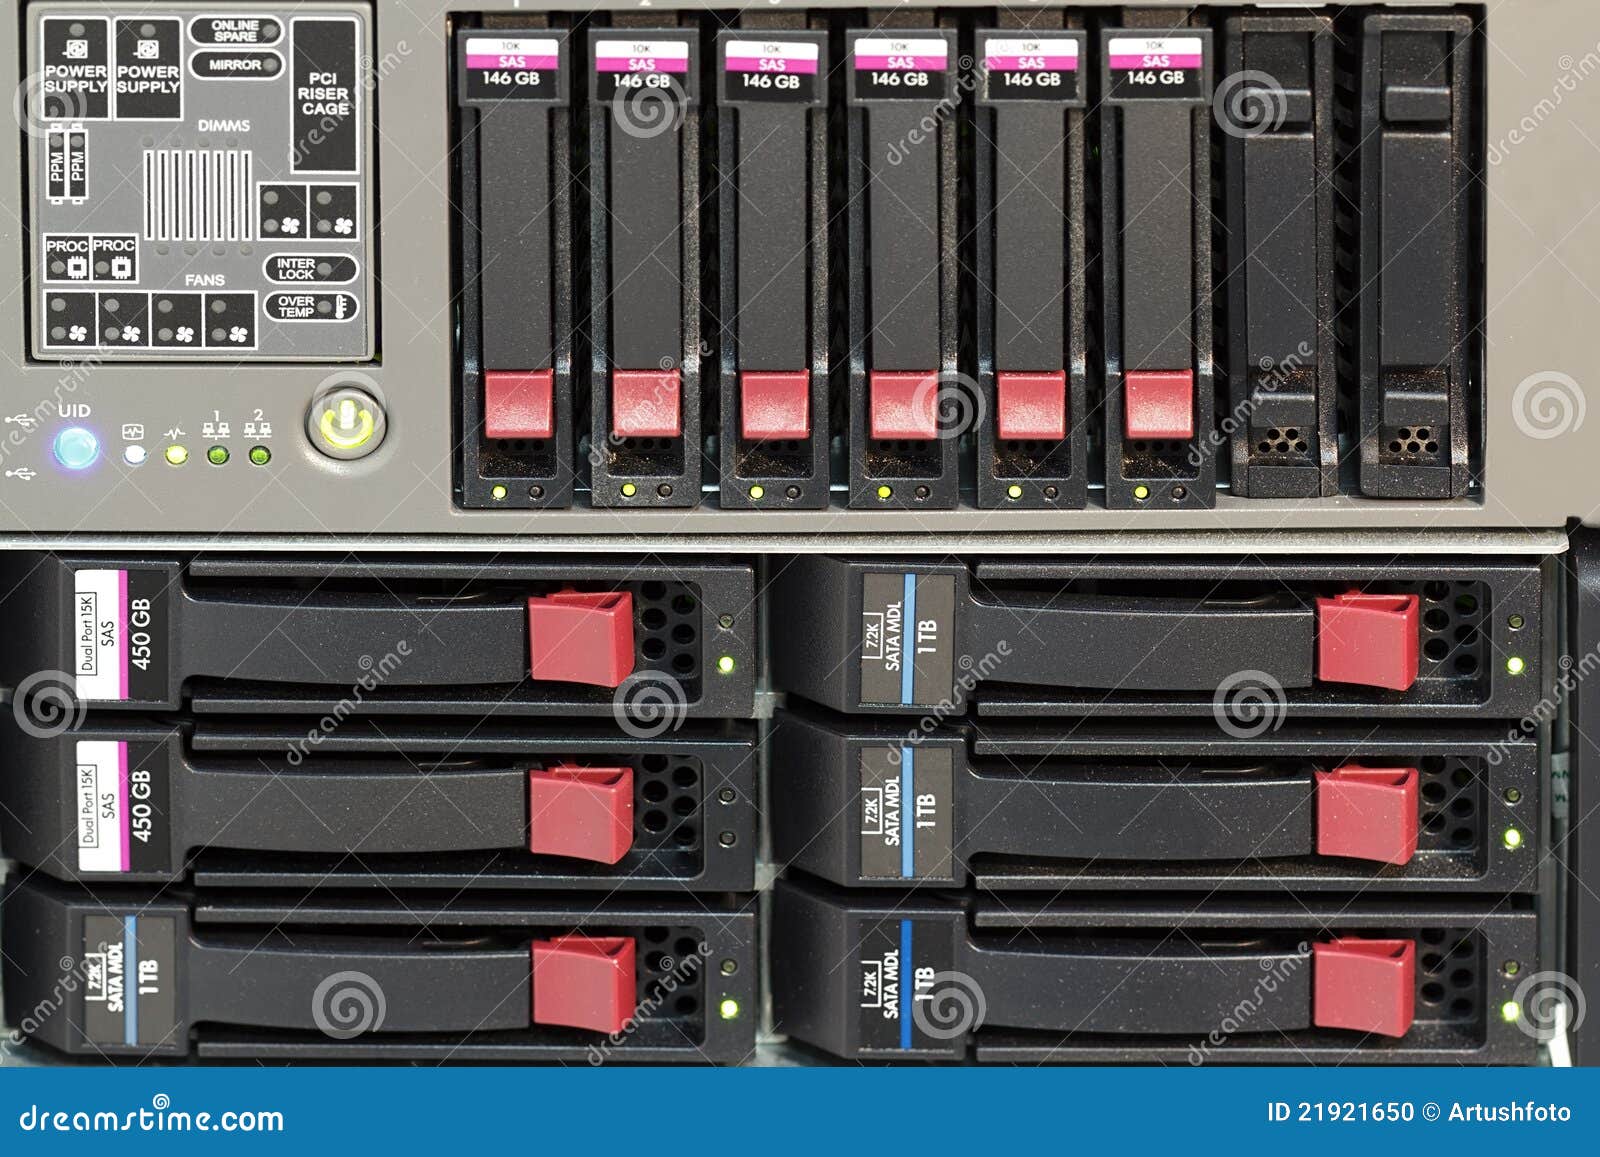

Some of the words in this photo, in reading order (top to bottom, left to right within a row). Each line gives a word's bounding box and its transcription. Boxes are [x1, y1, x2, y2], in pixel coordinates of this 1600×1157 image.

[212, 20, 260, 31] ONLINE
[214, 32, 258, 42] SPARE
[502, 42, 520, 50] 10K
[632, 45, 651, 53] 10K
[763, 45, 782, 53] 10K
[890, 43, 908, 51] 10K
[1022, 44, 1041, 52] 10K
[1146, 41, 1164, 49] 10K
[210, 60, 262, 70] MIRROR
[499, 56, 526, 68] SAS
[628, 58, 656, 71] SAS
[759, 59, 786, 71] SAS
[888, 57, 914, 69] SAS
[1018, 57, 1045, 69] SAS
[1142, 56, 1170, 68] SAS
[46, 66, 107, 78] POWER
[118, 66, 180, 78] POWER
[309, 72, 337, 85] PCI
[483, 72, 512, 85] 146
[515, 72, 540, 86] GB
[872, 72, 900, 86] 146
[904, 73, 928, 86] GB
[1004, 72, 1032, 86] 146
[1036, 73, 1061, 86] GB
[1128, 71, 1156, 84] 146
[1160, 71, 1184, 84] GB
[44, 80, 108, 94] SUPPLY
[117, 81, 180, 94] SUPPLY
[614, 74, 642, 88] 146
[646, 75, 670, 88] GB
[742, 74, 771, 88] 146
[775, 76, 800, 89] GB
[298, 87, 349, 100] RISER
[302, 102, 350, 115] CAGE
[198, 120, 250, 132] DIMMS
[51, 152, 64, 182] PPM
[72, 151, 84, 181] PPM
[46, 240, 88, 252] PROC
[93, 240, 136, 252] PROC
[278, 258, 315, 269] INTER
[186, 274, 225, 286] FANS
[279, 270, 314, 280] LOCK
[278, 296, 314, 307] OVER
[278, 307, 314, 318] TEMP
[58, 404, 91, 418] UID
[214, 410, 220, 422] 1
[254, 410, 263, 421] 2
[81, 597, 92, 616] 15K
[132, 598, 150, 628] GB
[886, 601, 902, 632] MDL
[82, 620, 92, 641] Port
[101, 621, 114, 646] SAS
[866, 624, 878, 648] 7.2K
[918, 620, 937, 643] TB
[132, 632, 151, 670] 450
[885, 636, 900, 672] SATA
[81, 646, 93, 671] Dual
[81, 770, 93, 788] 15K
[132, 770, 151, 800] GB
[884, 776, 900, 808] MDL
[82, 792, 93, 813] Port
[102, 794, 115, 819] SAS
[916, 794, 936, 817] TB
[865, 798, 878, 823] 7.2K
[82, 818, 94, 842] Dual
[132, 804, 152, 842] 450
[884, 810, 900, 846] SATA
[108, 942, 123, 974] MDL
[884, 949, 898, 980] MDL
[138, 960, 158, 984] TB
[914, 967, 935, 990] TB
[138, 987, 159, 995] 1
[864, 972, 877, 996] 7.2K
[107, 976, 124, 1012] SATA
[883, 983, 899, 1019] SATA
[914, 994, 935, 1002] 1
